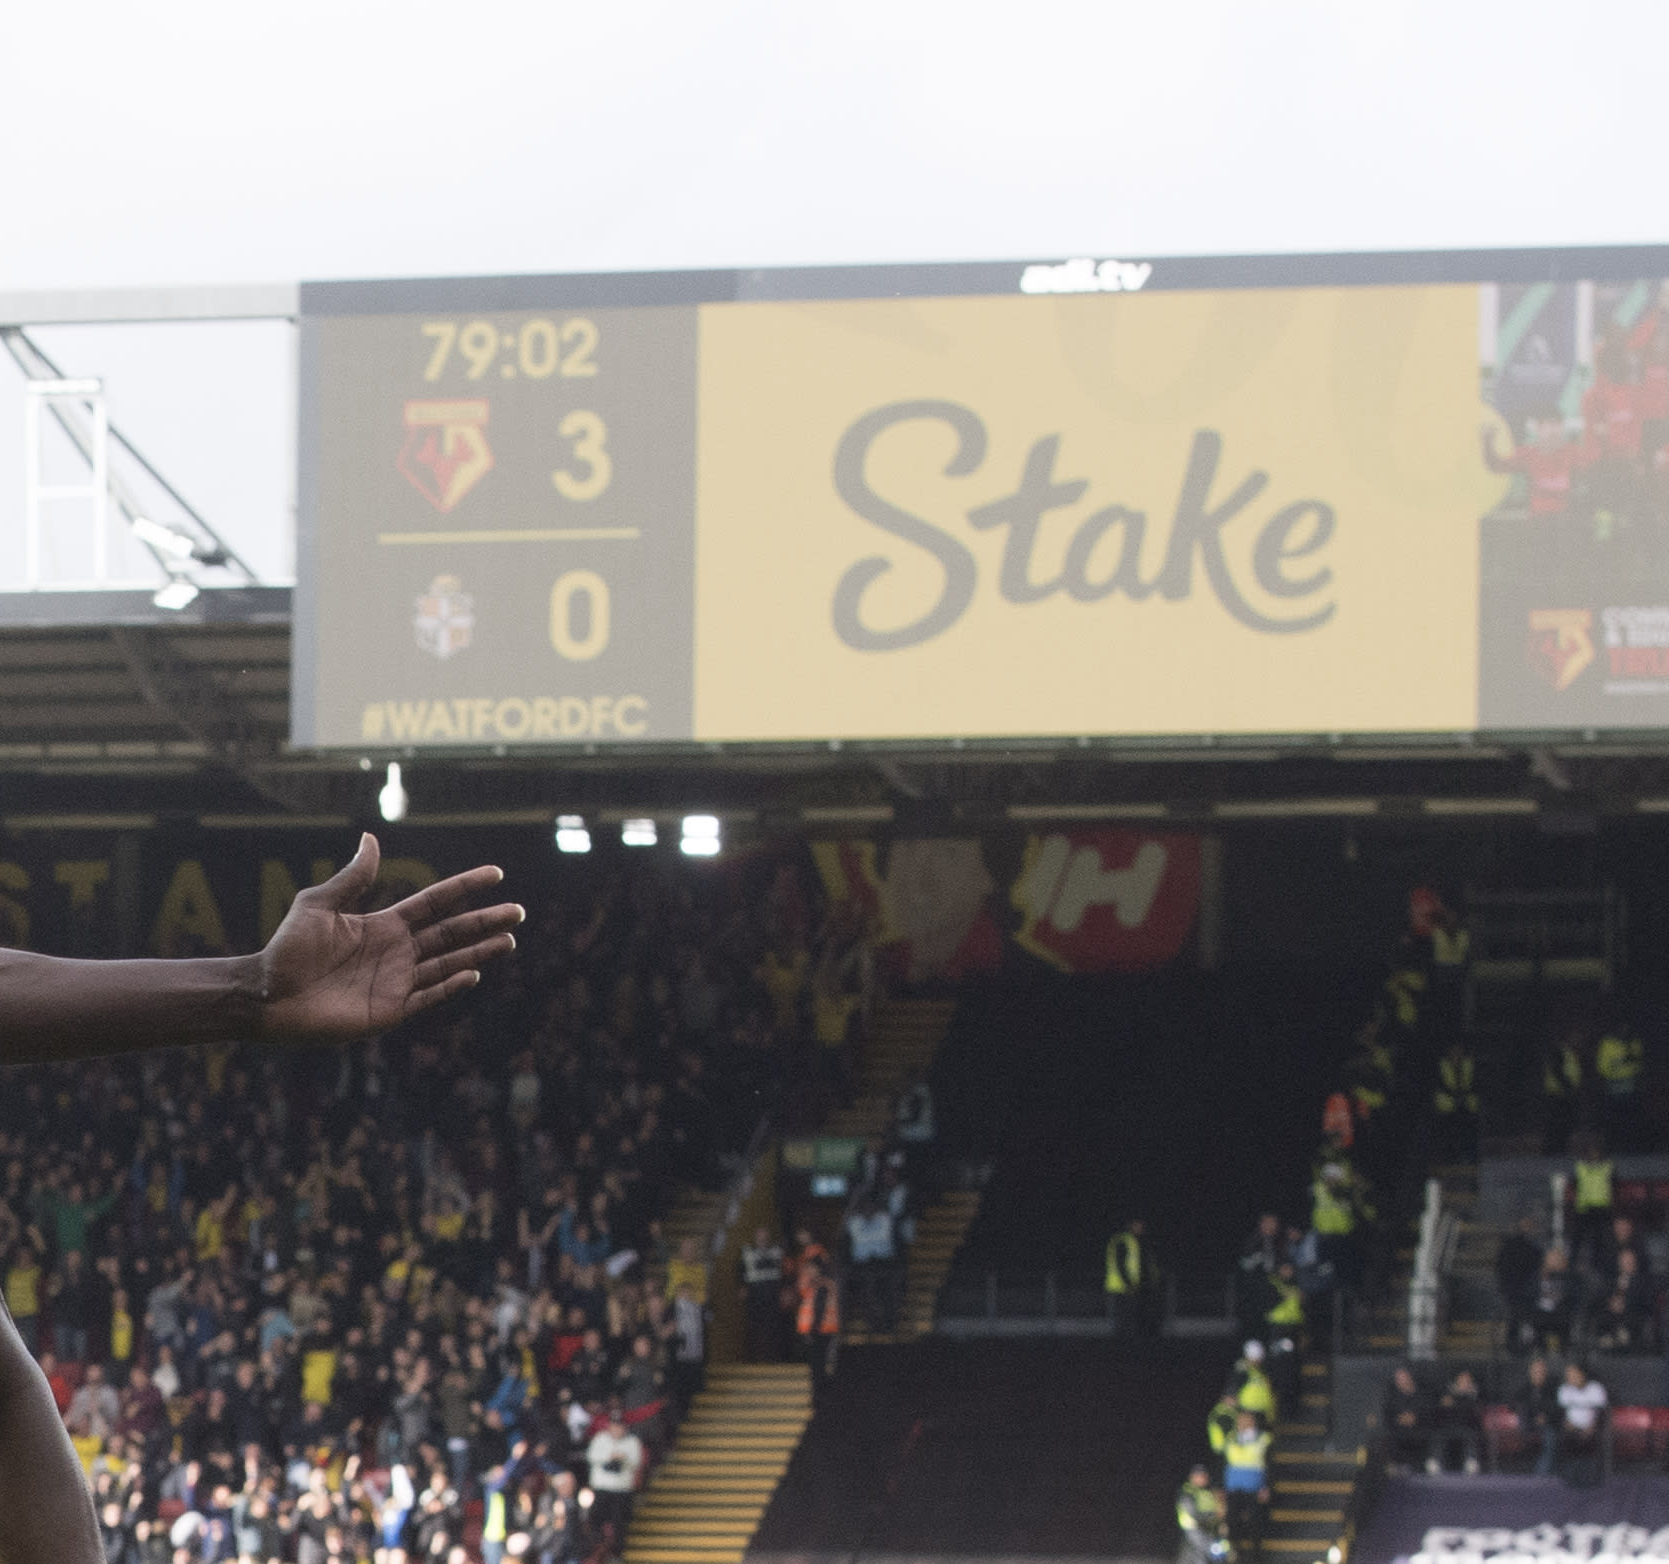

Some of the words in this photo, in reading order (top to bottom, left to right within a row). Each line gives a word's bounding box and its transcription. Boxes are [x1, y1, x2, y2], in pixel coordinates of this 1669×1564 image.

[420, 317, 601, 382] 79:02
[550, 409, 613, 501] 3
[830, 398, 1337, 653] Stake
[548, 568, 611, 662] 0
[360, 694, 651, 741] #WATFORDFC
